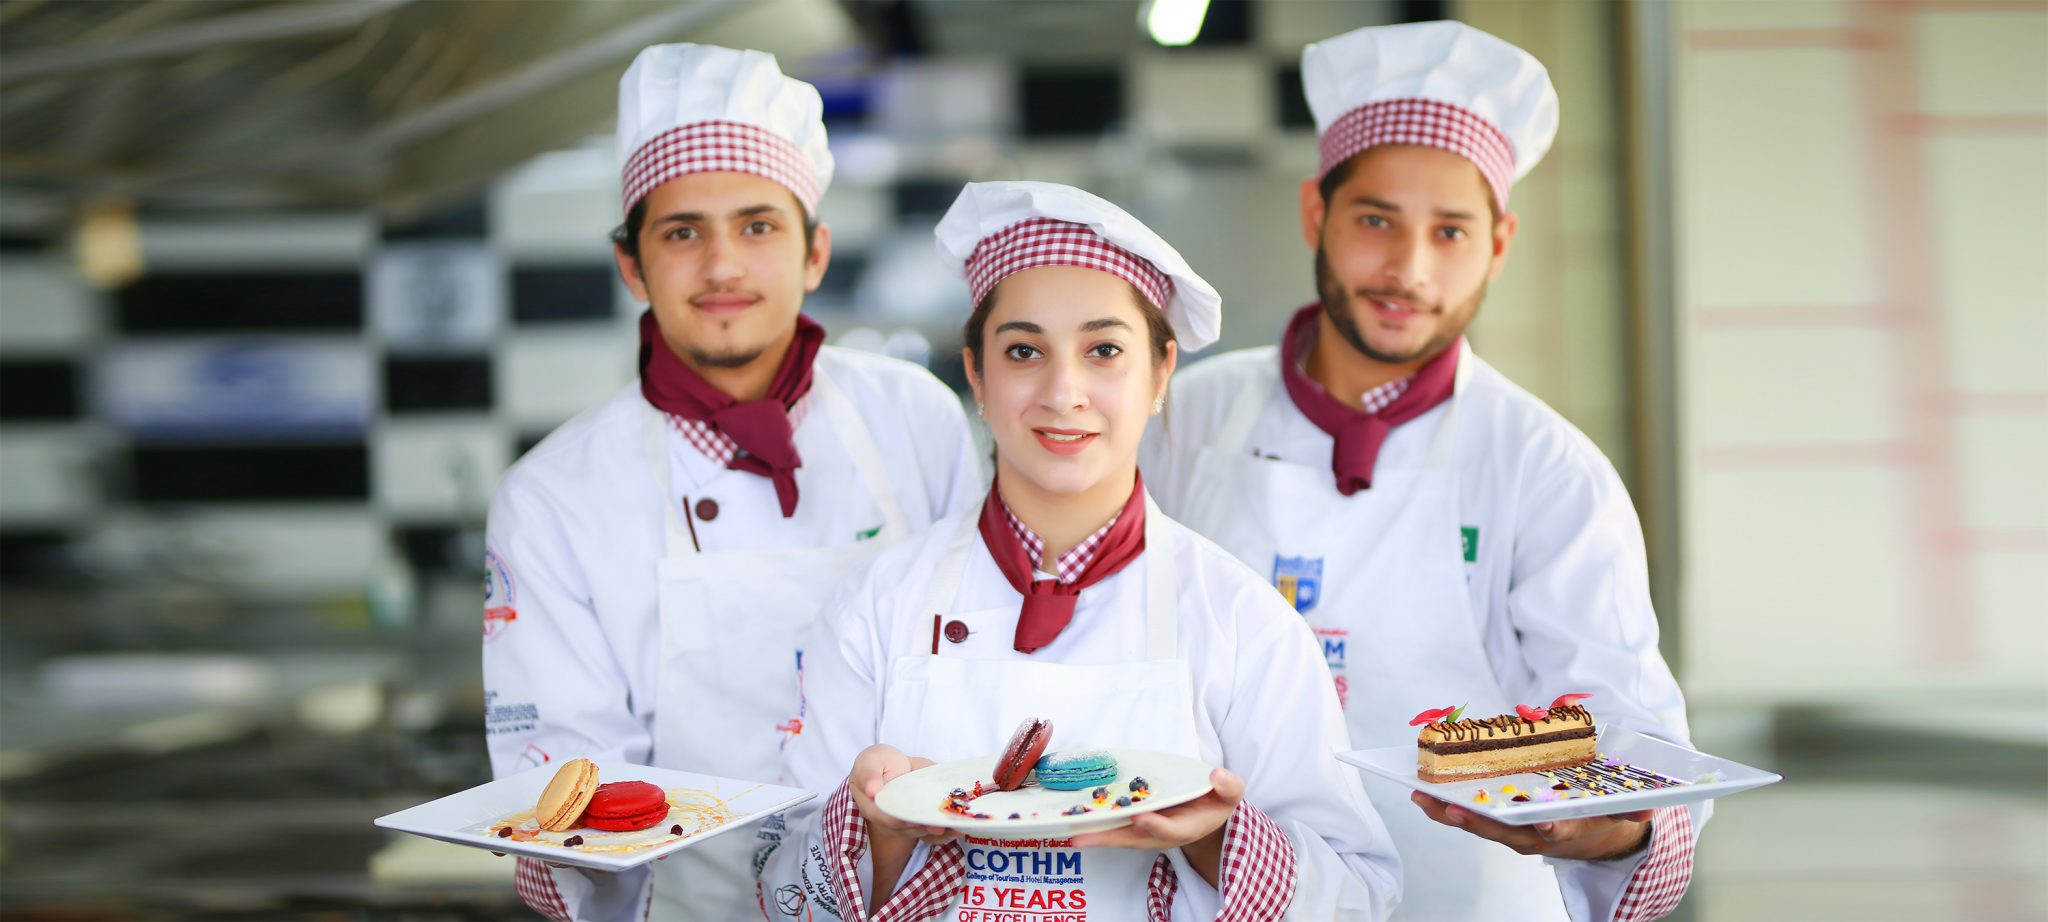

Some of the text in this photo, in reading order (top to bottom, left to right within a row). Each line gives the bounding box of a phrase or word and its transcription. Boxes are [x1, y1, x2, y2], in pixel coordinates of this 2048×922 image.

[1000, 839, 1042, 849] Hospitality
[1043, 838, 1072, 848] Educati
[967, 849, 1081, 874] COTHM
[966, 871, 1084, 885] College of Tourism & Hotel Management
[960, 885, 1087, 909] 15 YEARS
